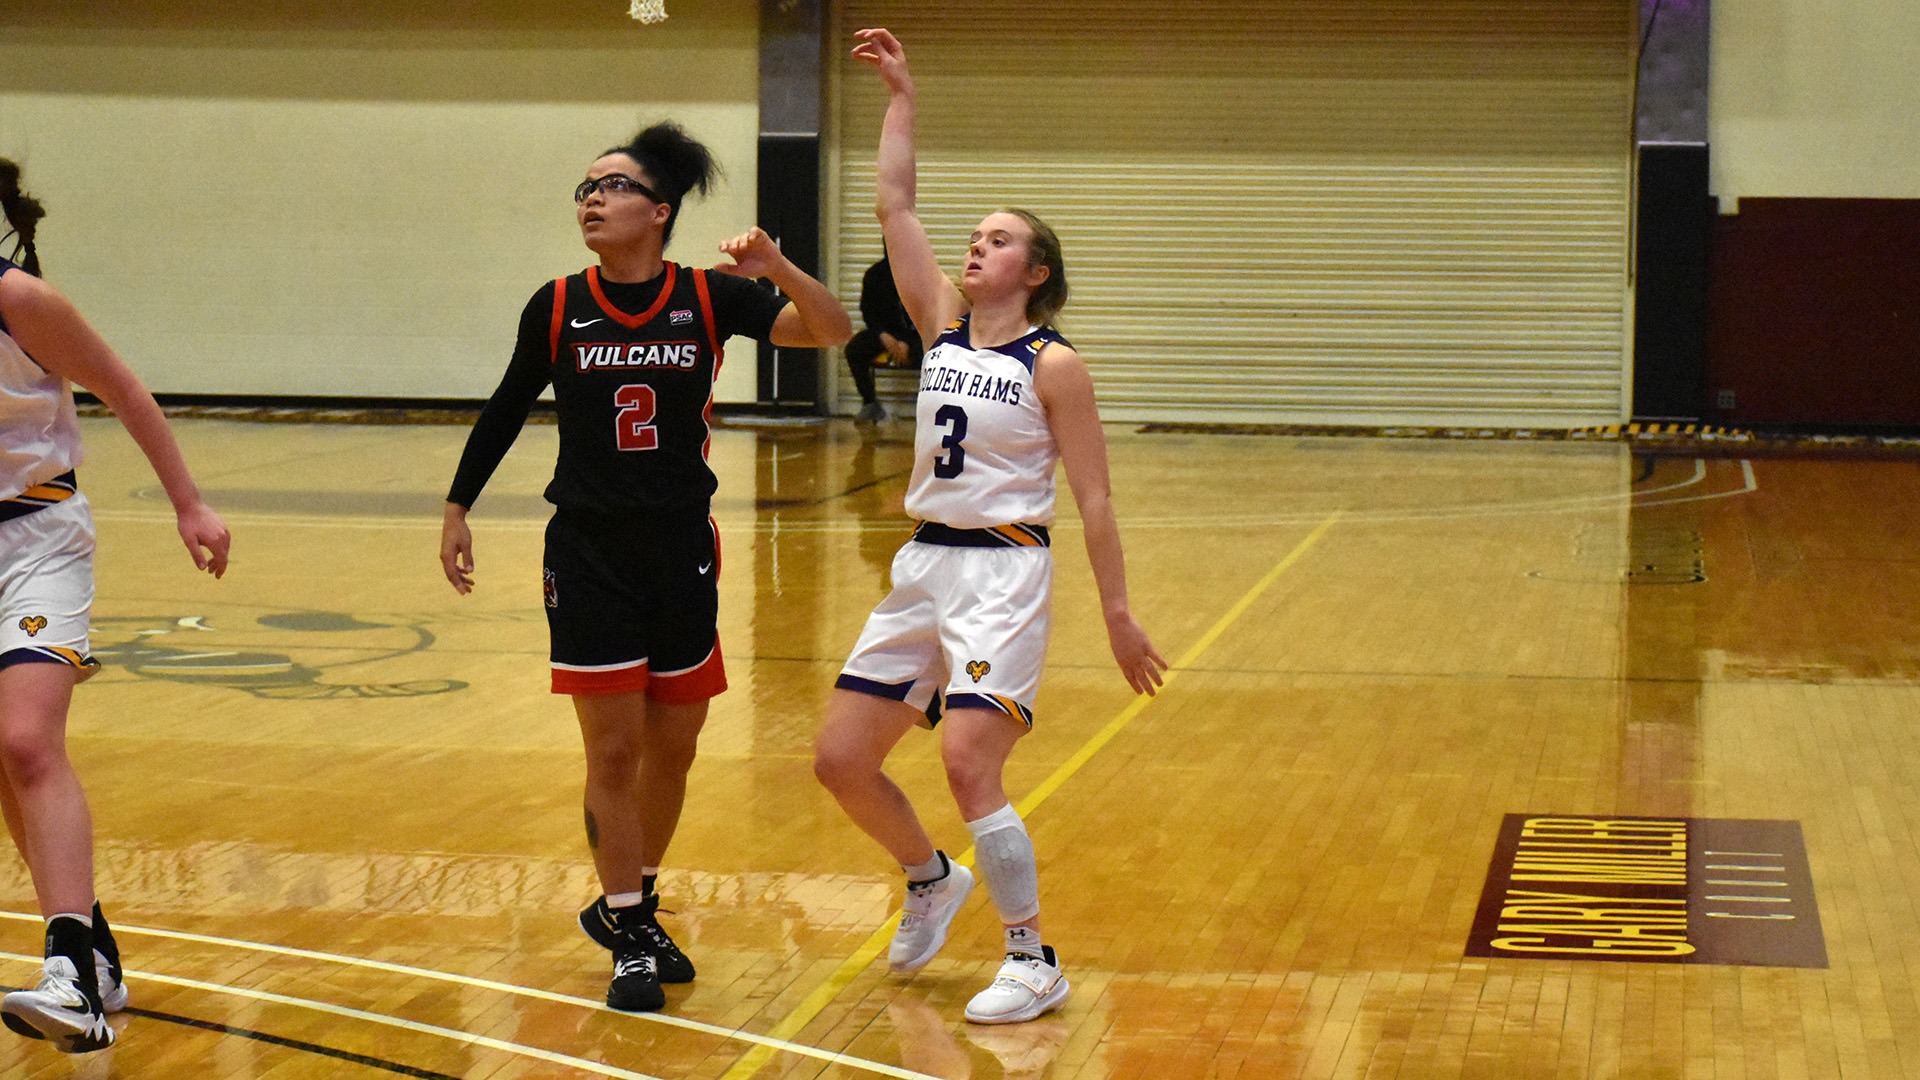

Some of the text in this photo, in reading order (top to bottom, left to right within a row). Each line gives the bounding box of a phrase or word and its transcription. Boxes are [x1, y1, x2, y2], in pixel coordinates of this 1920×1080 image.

[575, 343, 699, 372] VULCANS
[919, 367, 1022, 406] OLDEN RAMS
[614, 384, 658, 451] 2
[934, 404, 968, 479] 3
[1490, 818, 1696, 956] GARY MILLER
